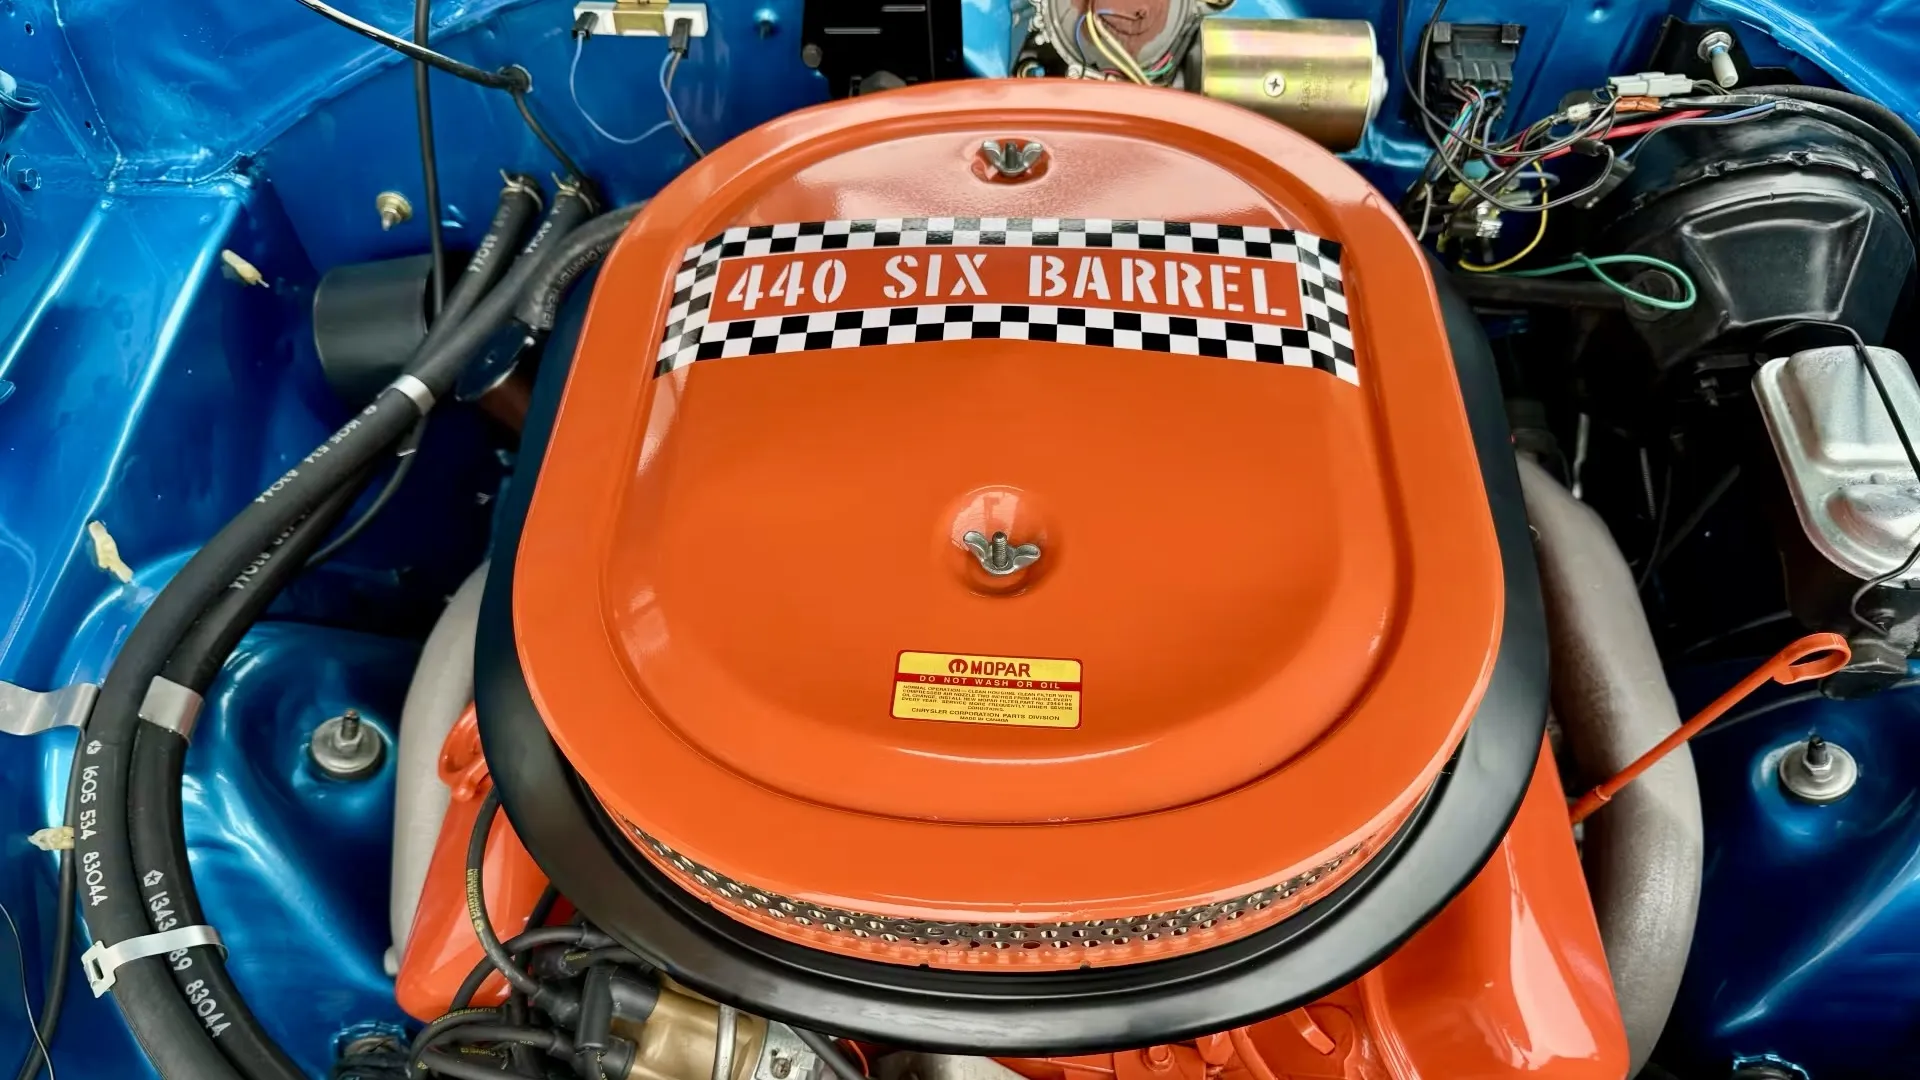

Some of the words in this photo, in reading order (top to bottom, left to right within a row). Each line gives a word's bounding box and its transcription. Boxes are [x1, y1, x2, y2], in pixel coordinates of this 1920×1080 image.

[728, 259, 847, 311] 440
[883, 253, 989, 299] SIX
[1029, 256, 1287, 317] BARREL
[970, 660, 1031, 677] MOPAR
[975, 679, 1009, 687] WASH
[80, 765, 100, 804] 1605
[80, 808, 97, 840] 534
[83, 851, 108, 907] 83044
[467, 868, 477, 919] CHRYSLER
[149, 891, 177, 932] 1343
[185, 979, 231, 1038] 83044
